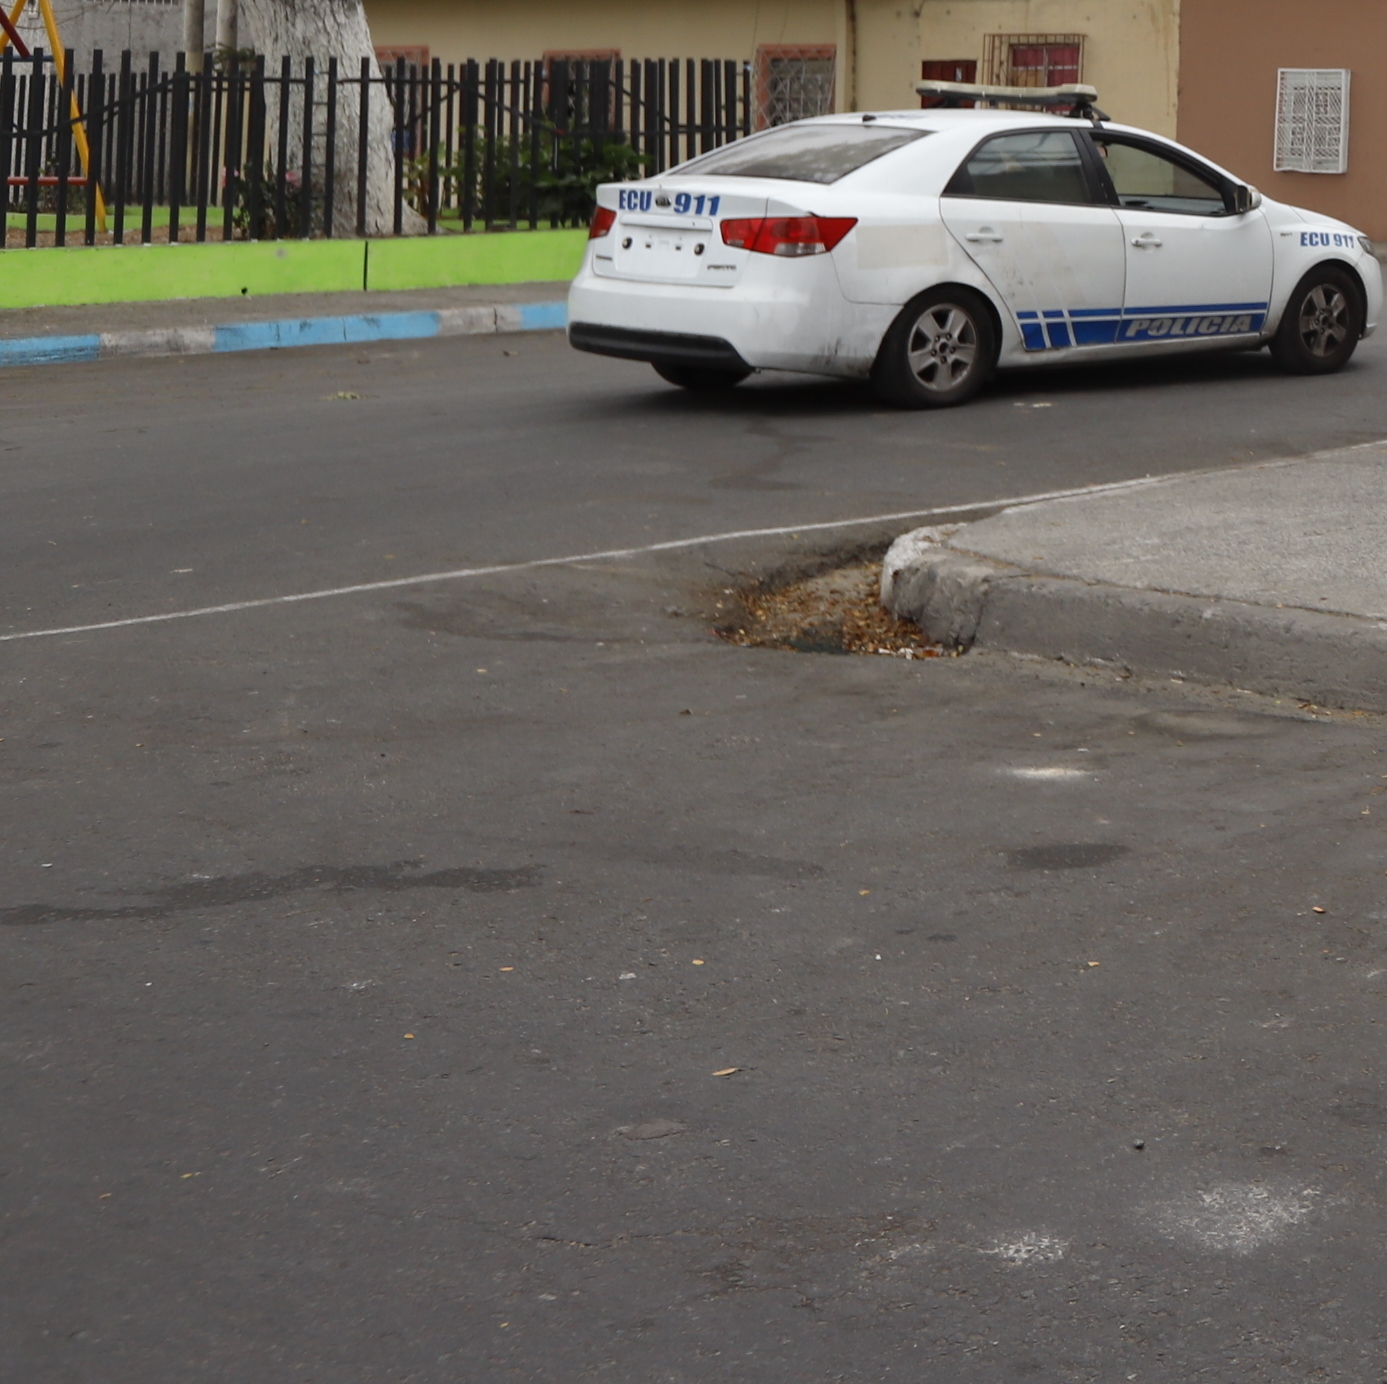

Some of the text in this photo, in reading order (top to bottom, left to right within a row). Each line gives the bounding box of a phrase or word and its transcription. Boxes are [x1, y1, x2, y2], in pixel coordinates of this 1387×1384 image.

[619, 190, 720, 216] ECU 911
[1301, 231, 1354, 248] ECU 911
[1125, 315, 1252, 338] POLICIA
